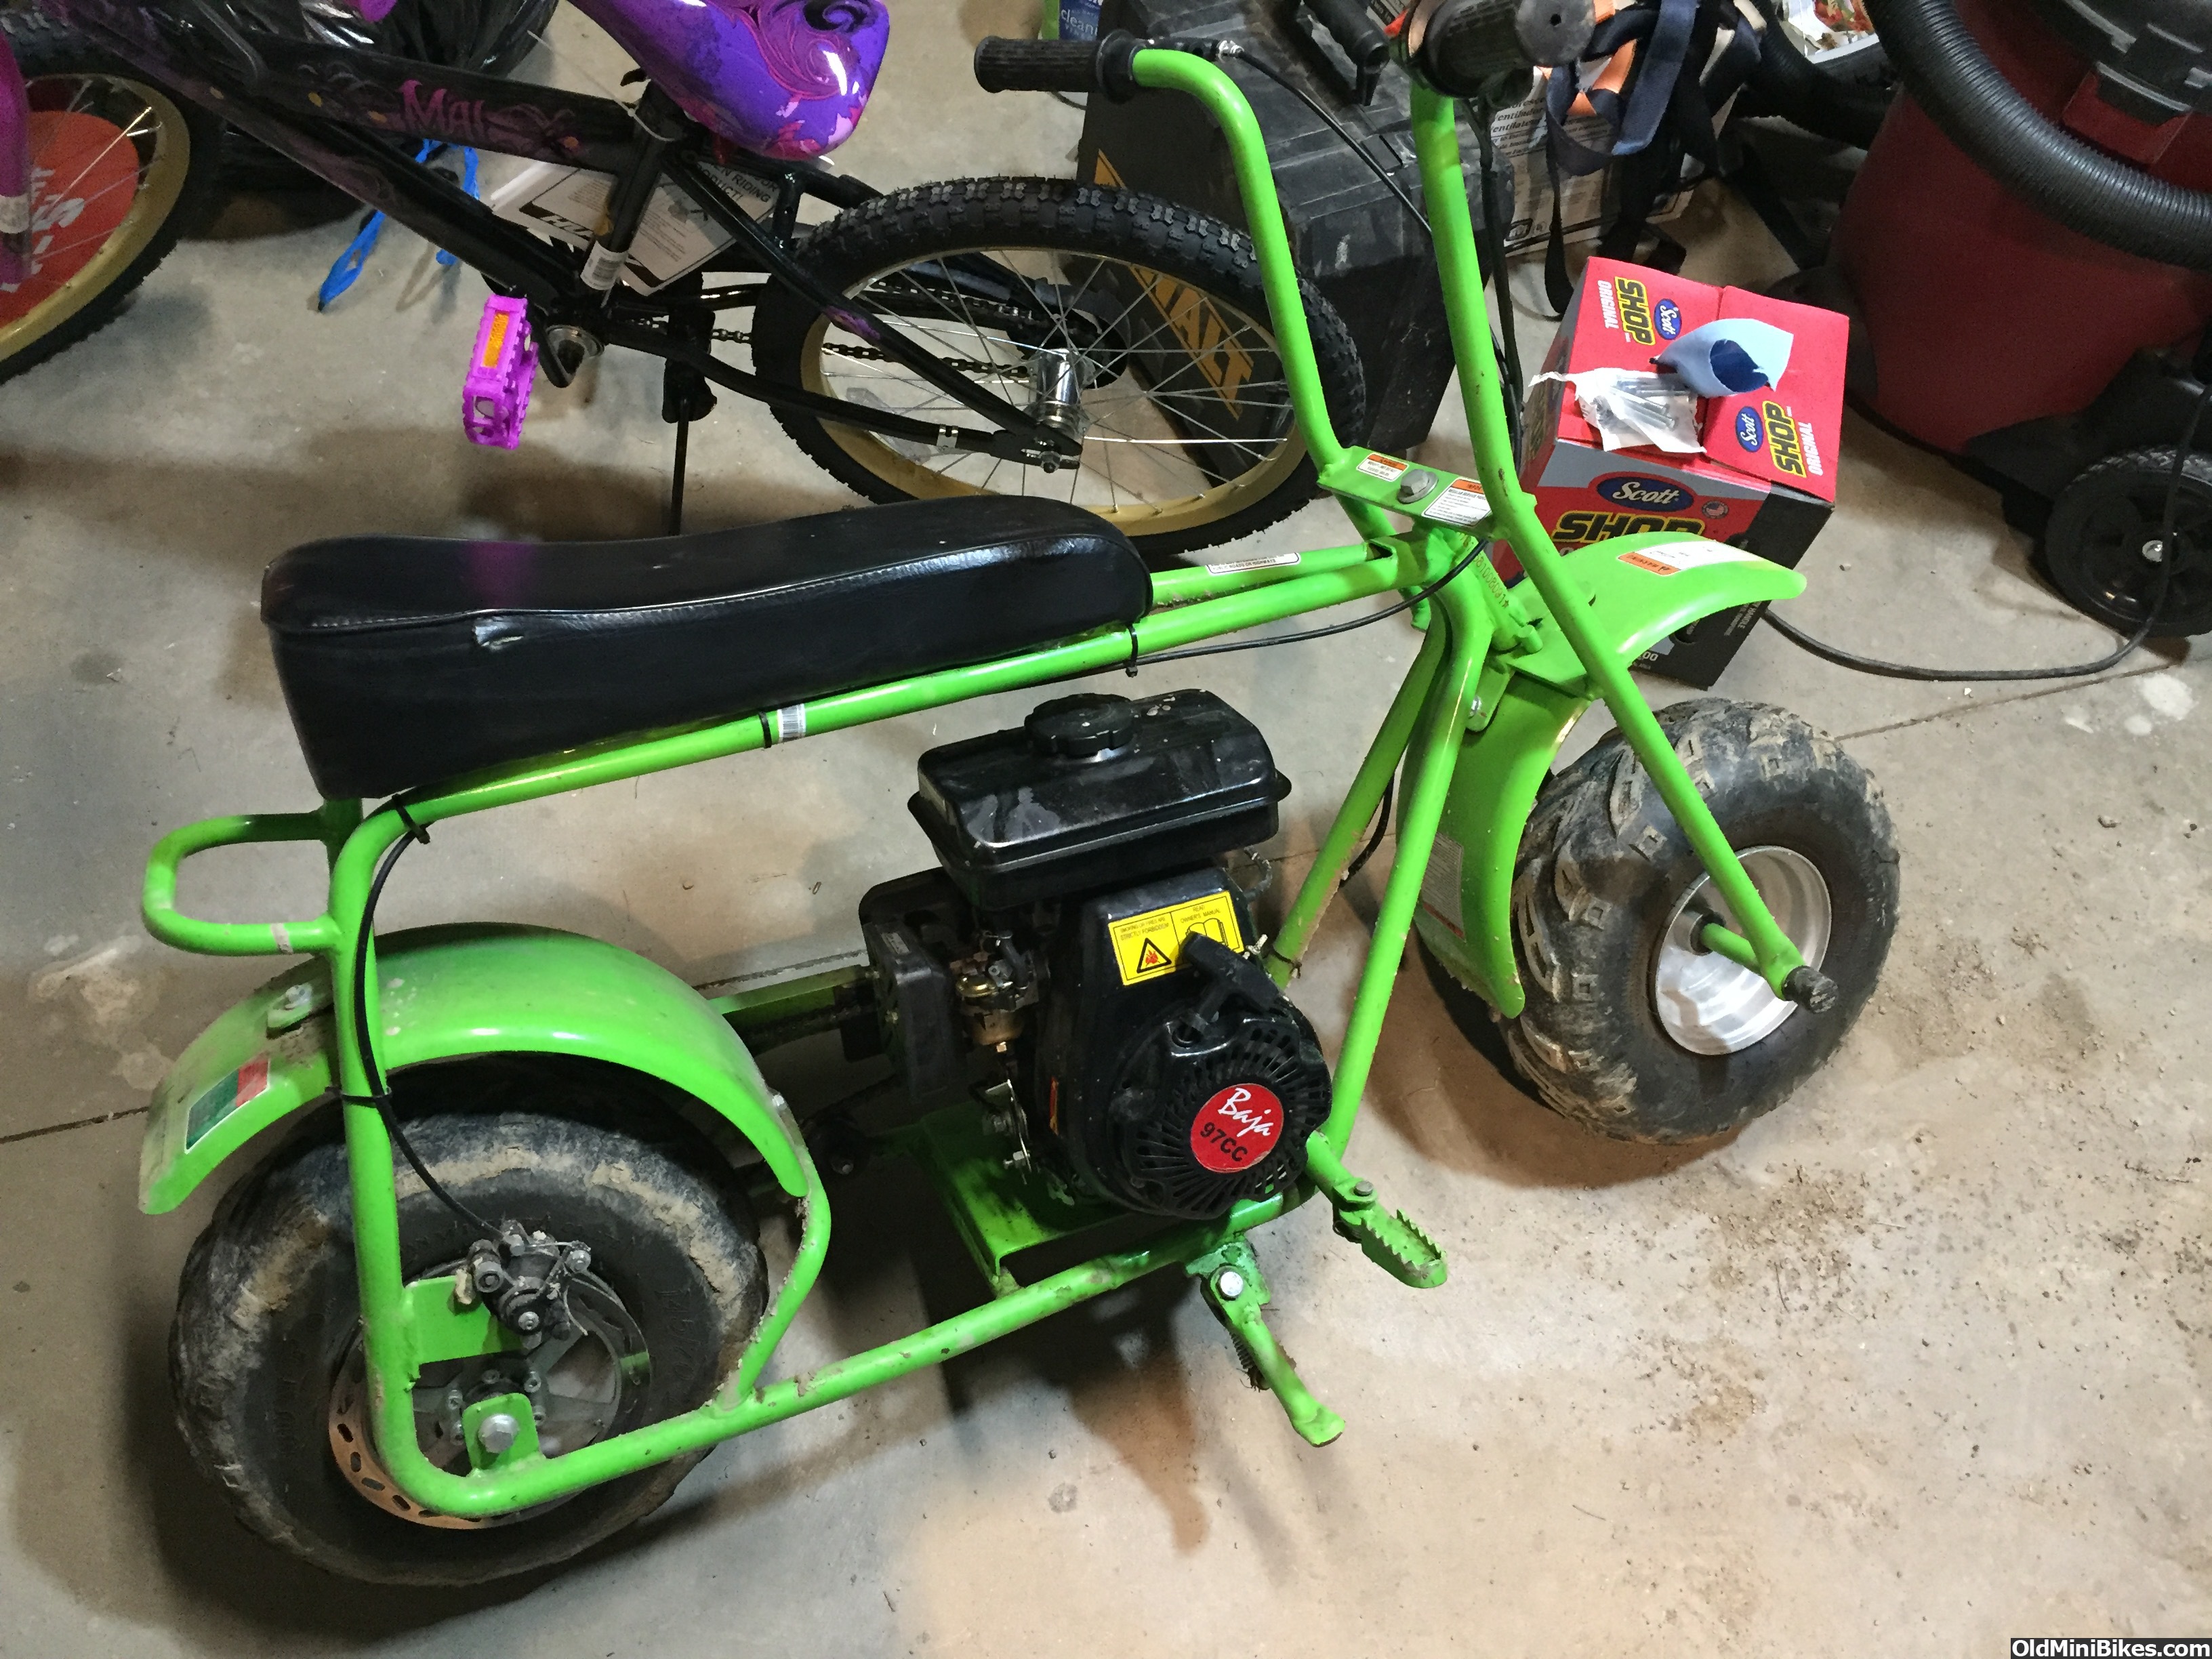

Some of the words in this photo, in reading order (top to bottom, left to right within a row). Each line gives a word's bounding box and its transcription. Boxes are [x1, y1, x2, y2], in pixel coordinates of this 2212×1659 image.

[731, 172, 771, 203] RIDING
[1597, 279, 1620, 329] ORIGINAL
[1614, 276, 1656, 346] SHOP
[1660, 305, 1678, 335] Scott
[1740, 413, 1759, 447] Scott
[1762, 399, 1807, 478] SHOP
[1797, 421, 1824, 476] ORIGINAL
[1612, 481, 1680, 505] Scott
[1203, 907, 1221, 918] MANUAL
[1218, 1088, 1274, 1137] Baja
[1200, 1122, 1248, 1162] 97CC
